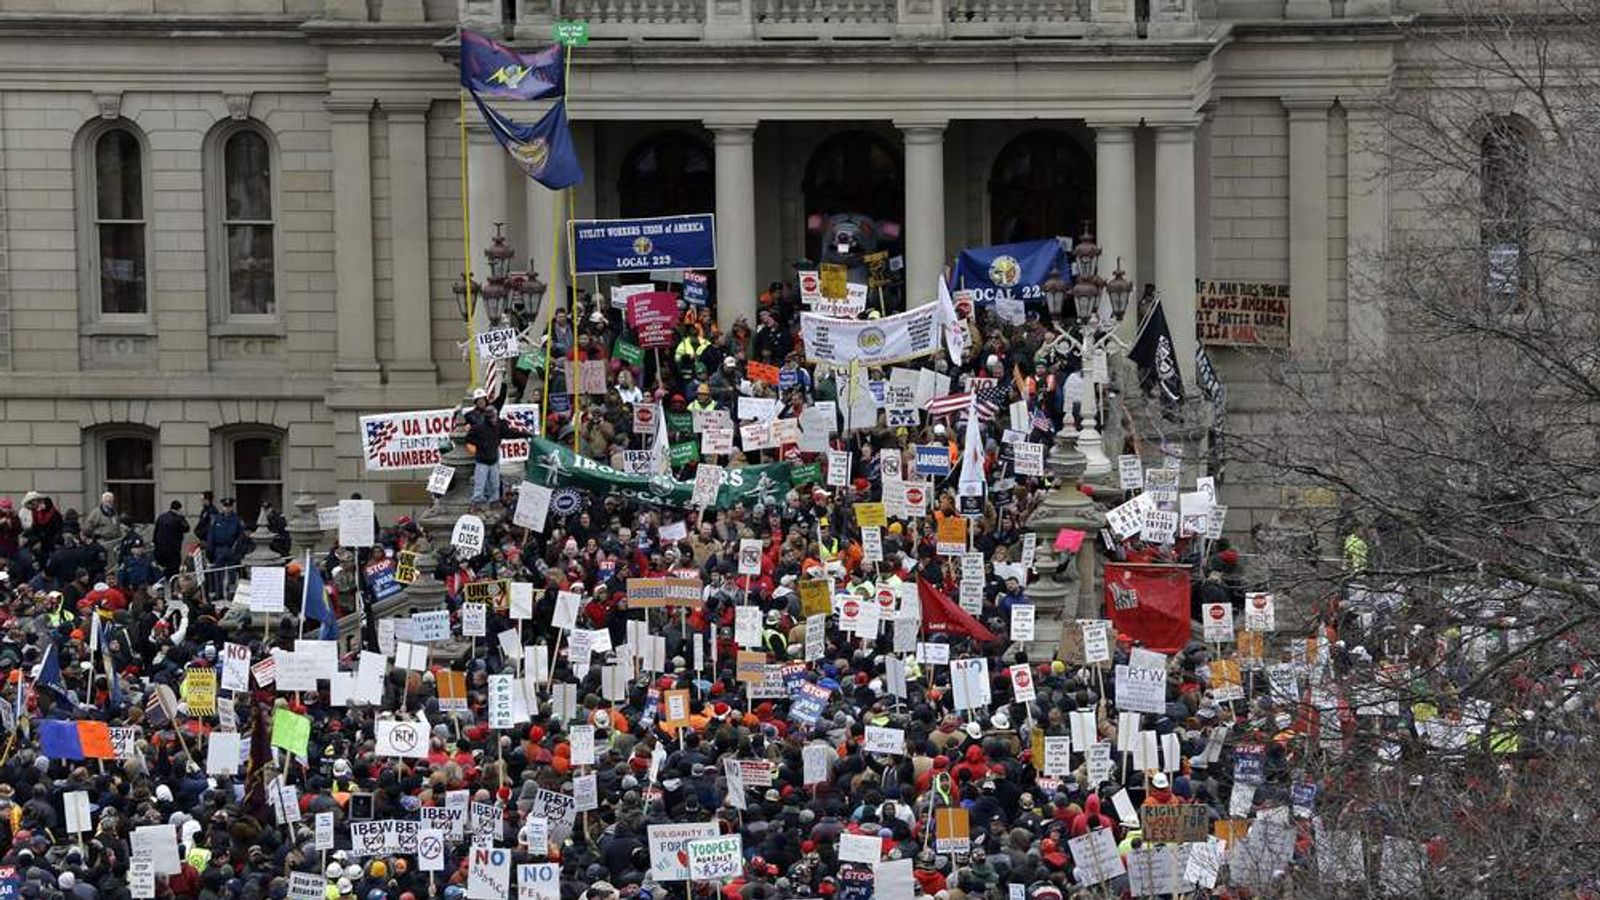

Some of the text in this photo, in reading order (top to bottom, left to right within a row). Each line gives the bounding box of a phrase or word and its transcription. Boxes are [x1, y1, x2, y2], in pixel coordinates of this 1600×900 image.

[578, 222, 704, 239] UTILITY WORKERS UNION of AMERICA
[616, 256, 672, 268] LOCAL 223
[974, 286, 1046, 302] OCAL 22
[1200, 296, 1286, 314] LOVES AMERICA
[480, 329, 514, 345] IBEW
[402, 418, 421, 436] UA
[379, 442, 528, 467] PLUMBERS TERS
[366, 560, 392, 576] STOP
[468, 582, 506, 597] UNIN
[227, 644, 248, 660] NO
[782, 662, 806, 675] STOP
[1128, 668, 1164, 682] RTW
[802, 684, 830, 699] STOP
[538, 790, 576, 809] IBEW
[422, 808, 462, 820] IBEW
[473, 804, 502, 820] IBEW
[353, 821, 394, 836] IBEW
[690, 840, 738, 856] YOOPERS
[475, 850, 505, 866] NO
[472, 866, 506, 898] JUSTICE
[524, 866, 553, 882] NO
[844, 870, 874, 881] STOP
